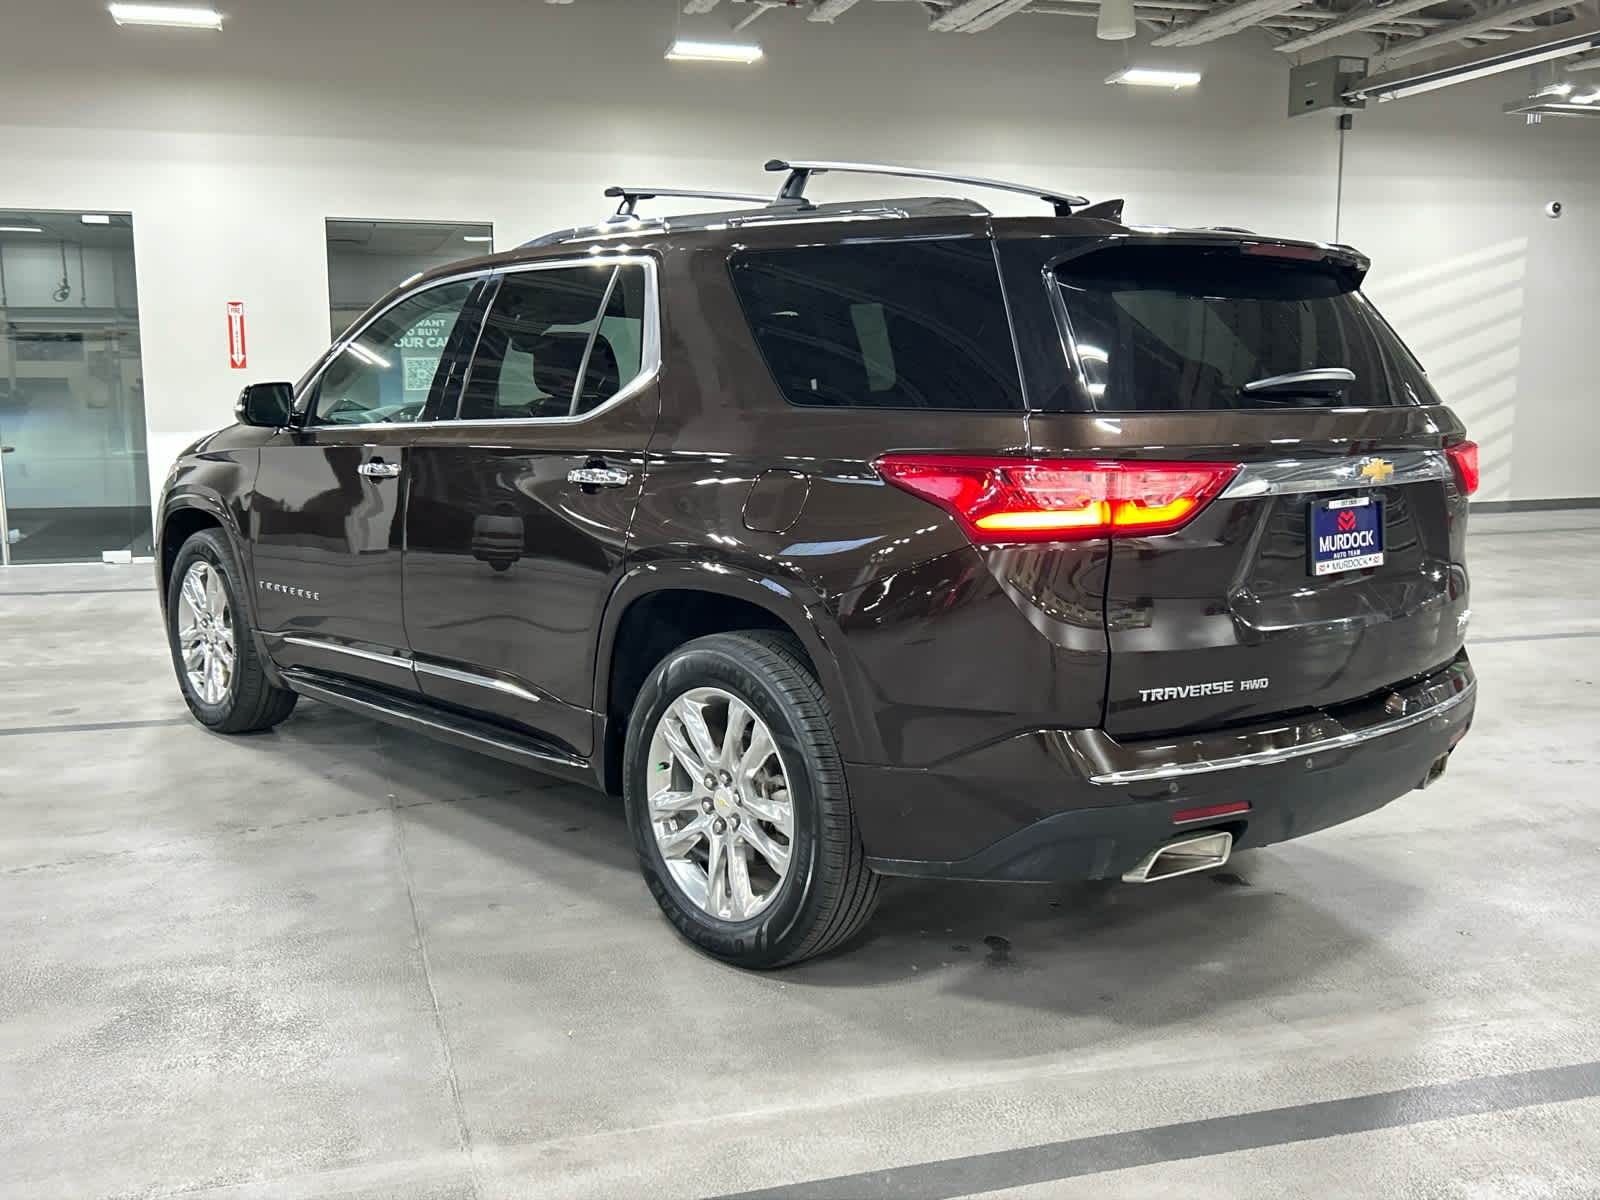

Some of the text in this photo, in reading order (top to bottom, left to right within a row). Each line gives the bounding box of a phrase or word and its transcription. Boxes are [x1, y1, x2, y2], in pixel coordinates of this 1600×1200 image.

[418, 328, 440, 336] BUY
[1319, 530, 1374, 552] MURDOCK
[1347, 549, 1361, 557] TEAM
[1332, 557, 1368, 570] MURDOCK
[259, 581, 319, 600] TRAVERSE
[1138, 677, 1269, 702] TRAVERSE AWD
